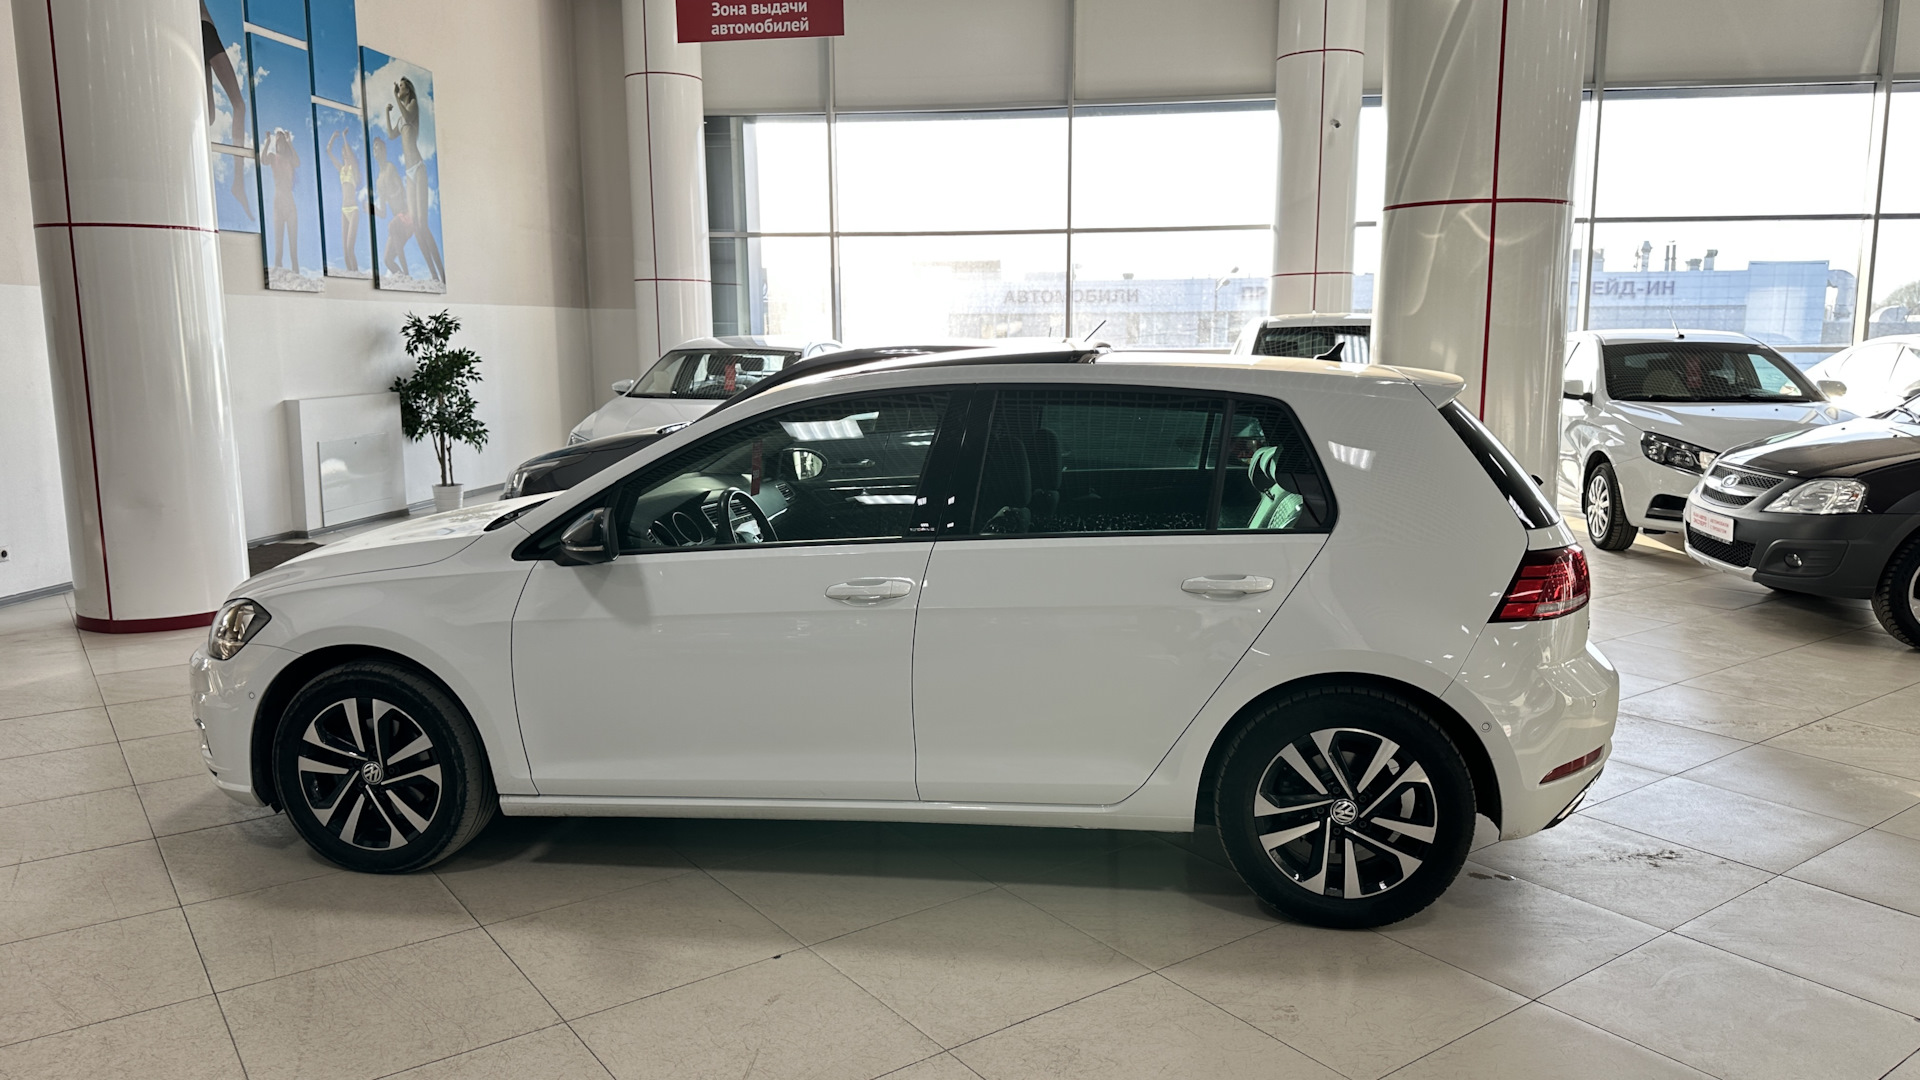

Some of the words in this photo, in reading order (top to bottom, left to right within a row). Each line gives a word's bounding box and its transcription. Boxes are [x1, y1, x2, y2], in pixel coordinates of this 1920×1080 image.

[711, 1, 747, 17] Зона
[751, 0, 808, 16] выдачи
[711, 17, 809, 35] автомобилей
[1570, 278, 1675, 298] ТЕЙД-ИН
